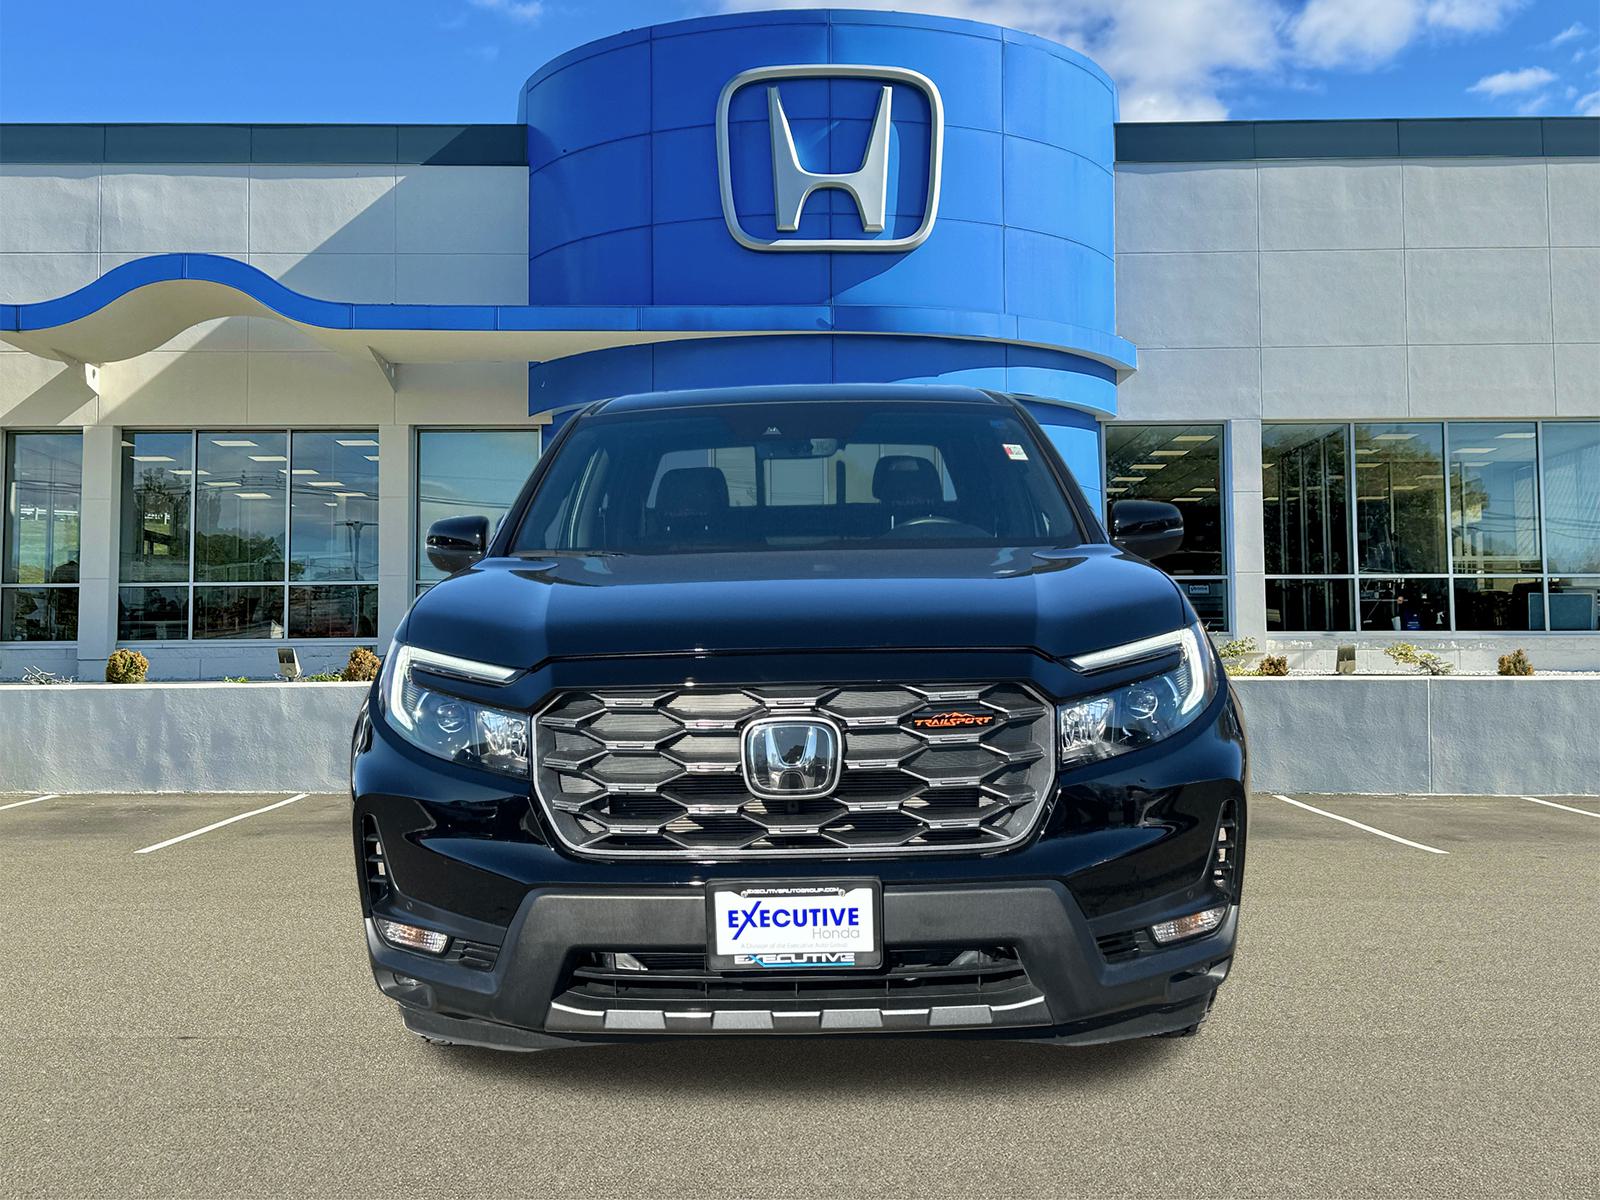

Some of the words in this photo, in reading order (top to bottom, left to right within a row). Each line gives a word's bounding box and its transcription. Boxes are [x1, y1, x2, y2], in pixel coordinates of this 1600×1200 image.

[914, 716, 993, 727] TRAILSPORT
[728, 901, 859, 940] EXECUTIVE
[812, 927, 860, 940] Honda
[734, 953, 855, 965] EXECUTIVE
